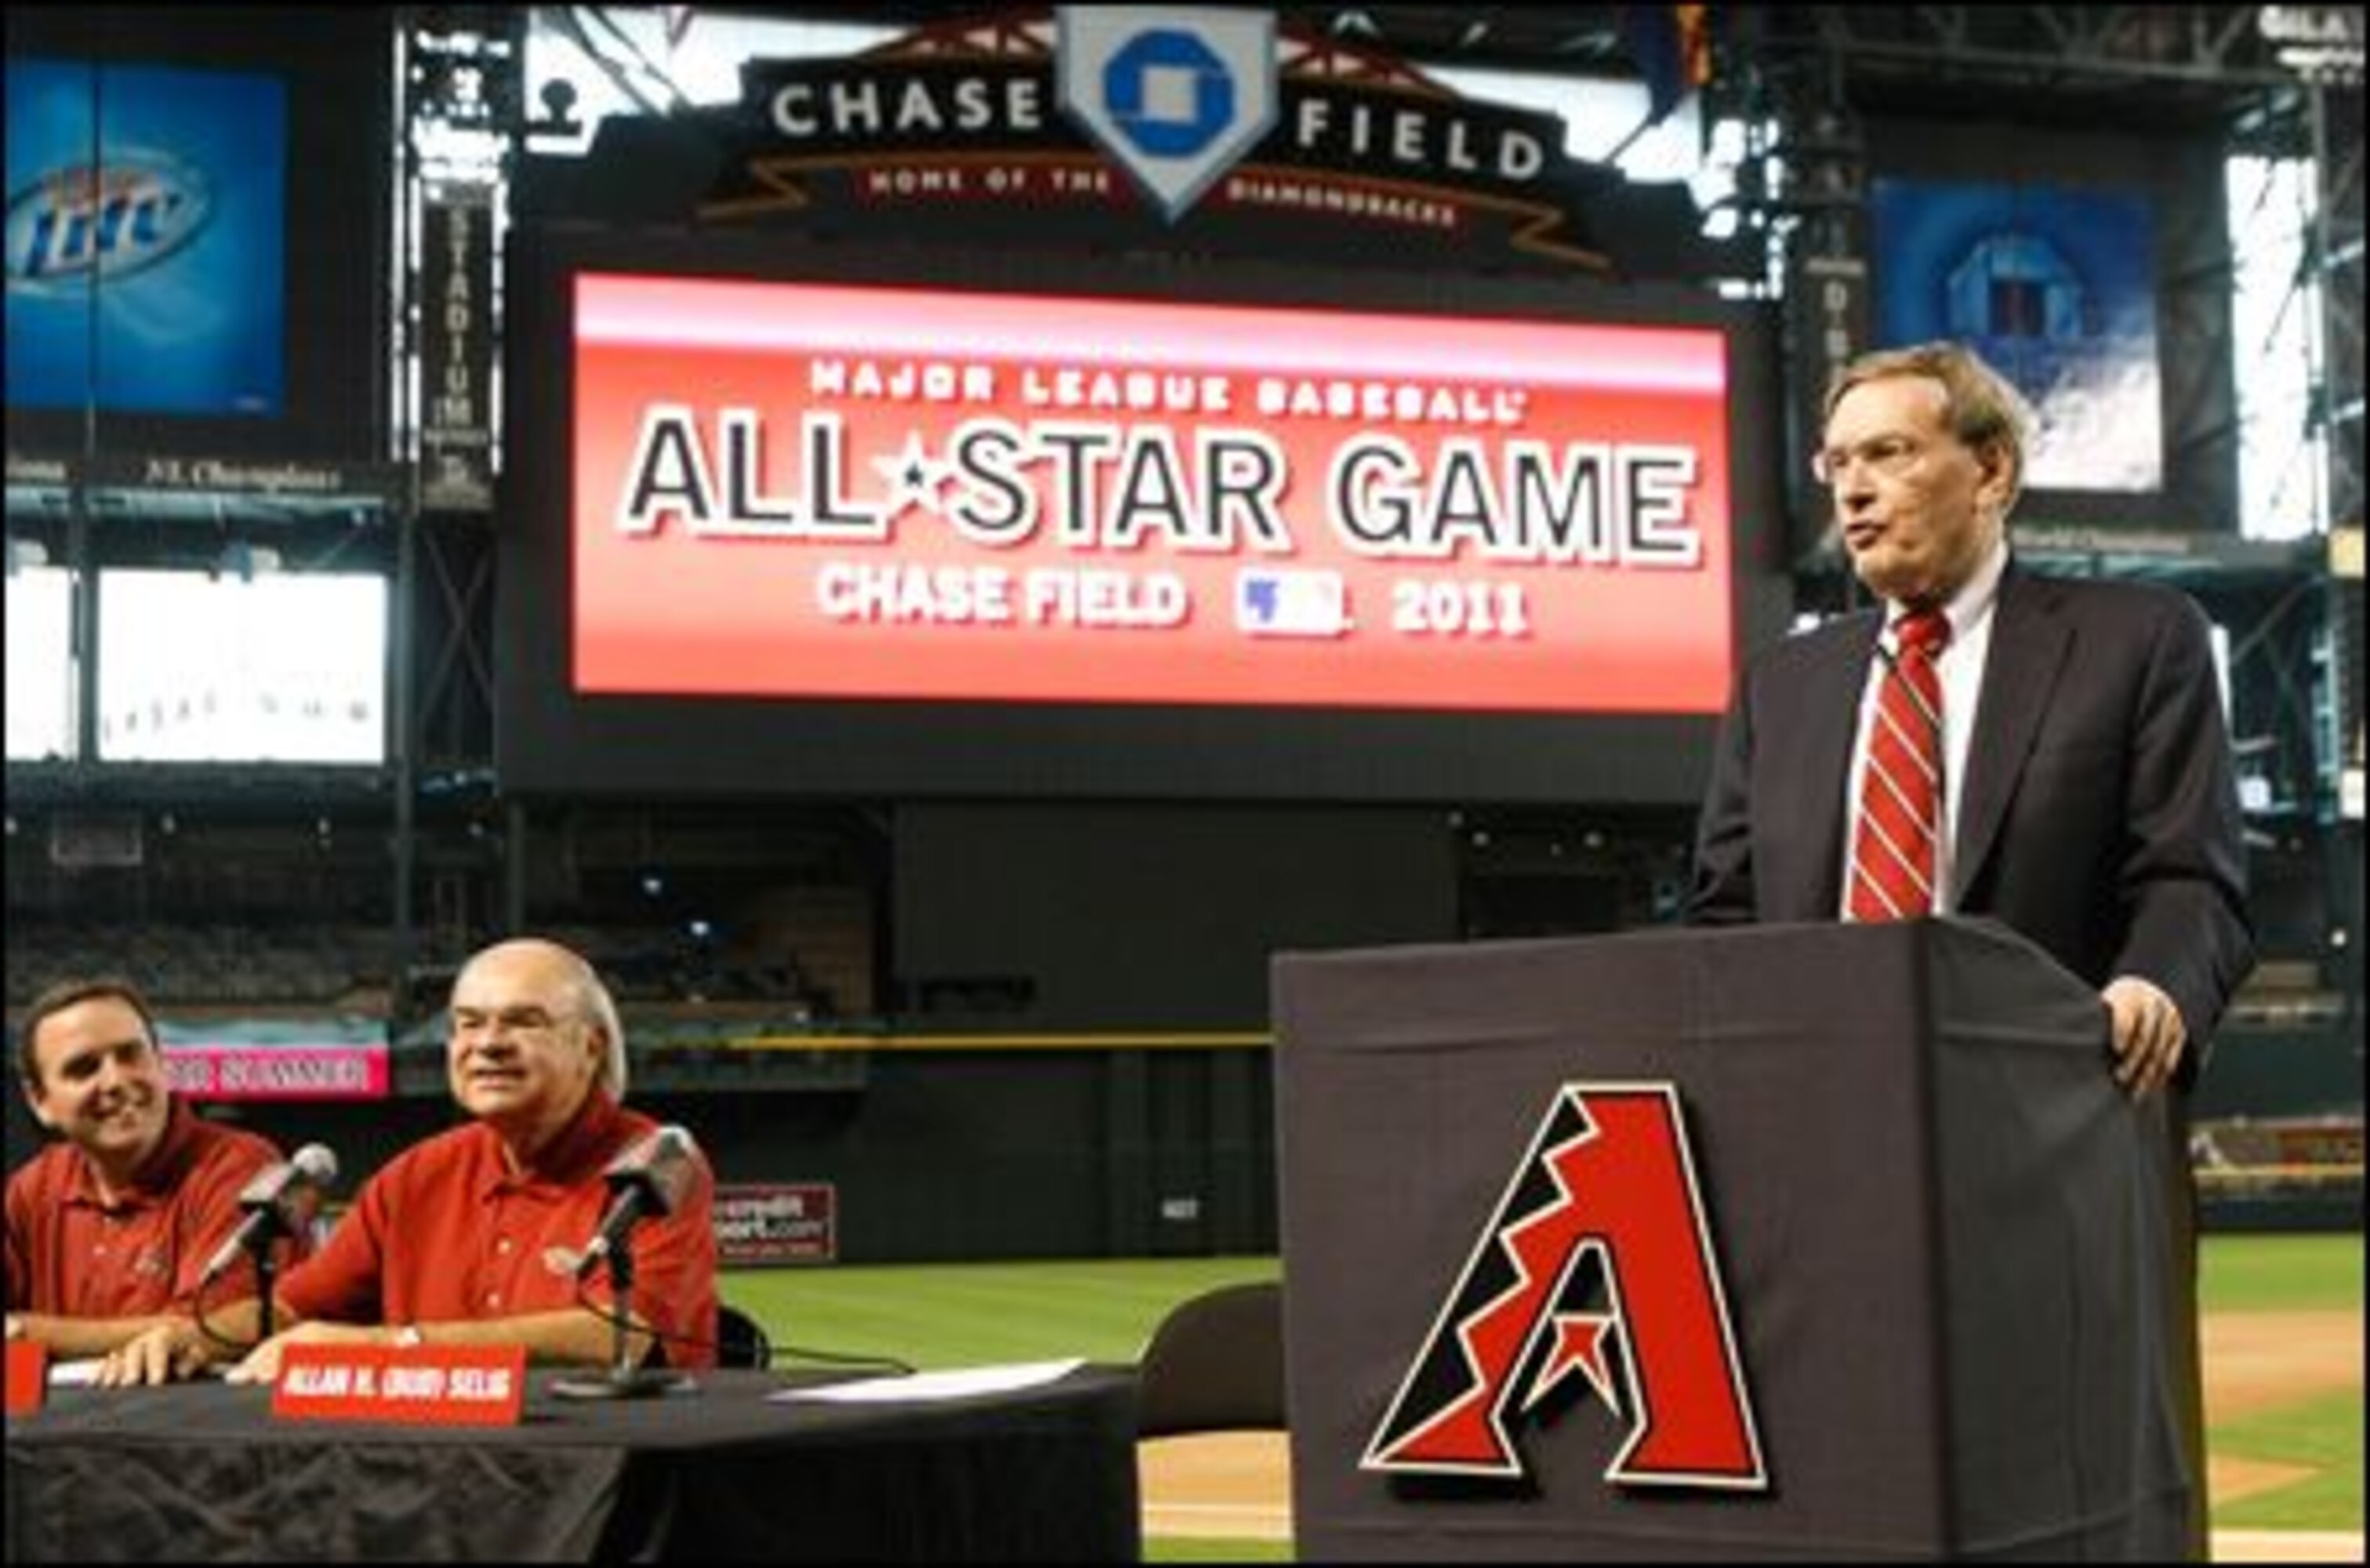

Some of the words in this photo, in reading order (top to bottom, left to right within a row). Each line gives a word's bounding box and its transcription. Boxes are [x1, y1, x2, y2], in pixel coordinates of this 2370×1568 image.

[772, 79, 1043, 136] CHASE
[1298, 99, 1544, 180] FIELD
[869, 168, 964, 193] HOME
[985, 168, 1025, 193] OF
[1051, 169, 1110, 194] THE
[1228, 177, 1457, 227] DIAMONDBACKS
[811, 359, 996, 401] MAJOR
[1023, 369, 1231, 413] LEAGUE
[1327, 433, 1704, 569] GAME
[815, 562, 1011, 622] CHASE
[1025, 569, 1187, 629] FIELD
[1392, 579, 1533, 638] 2011
[282, 1364, 351, 1396] ALLAN
[380, 1367, 445, 1402] (BUD)
[448, 1367, 510, 1402] SELIG
